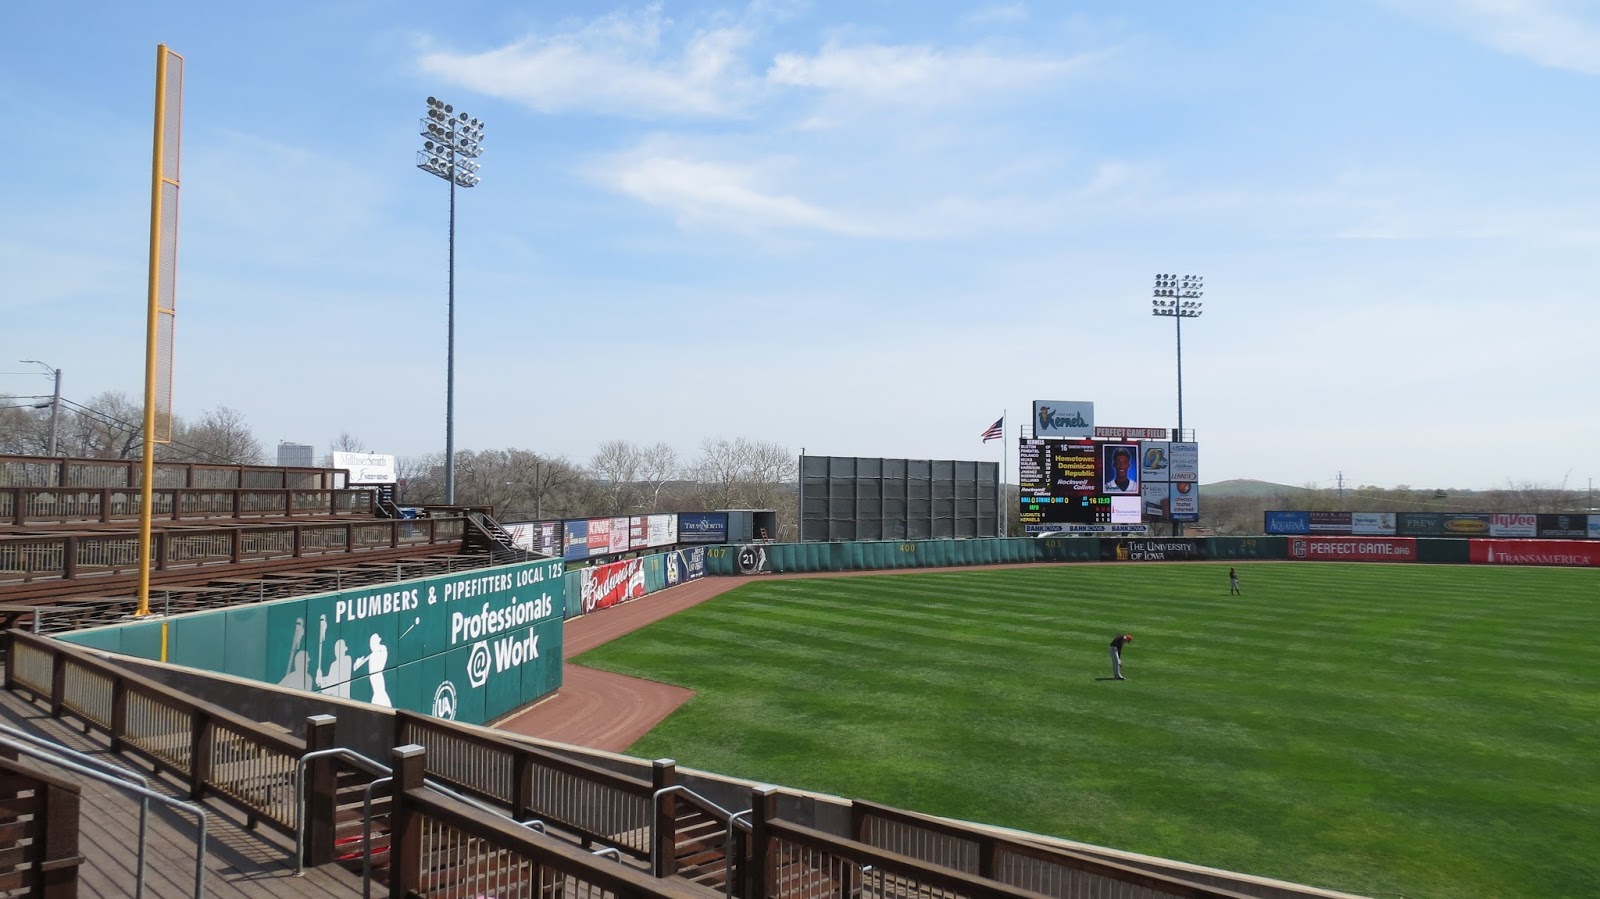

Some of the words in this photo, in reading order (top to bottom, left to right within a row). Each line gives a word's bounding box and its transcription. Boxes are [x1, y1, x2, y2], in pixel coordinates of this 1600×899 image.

[1041, 408, 1089, 430] Kernels
[1097, 428, 1126, 436] PERFECT
[1126, 428, 1146, 437] GAME
[1147, 429, 1164, 438] FIELD
[1270, 518, 1305, 531] AQUAFINA
[900, 544, 915, 552] 400
[1128, 542, 1145, 551] THE
[1147, 542, 1191, 551] UNIVERSITY
[1310, 543, 1356, 554] PERFECT
[1358, 543, 1409, 555] GAME.ORG
[707, 548, 725, 558] 407
[743, 554, 753, 564] 21
[1144, 551, 1165, 560] IOWA
[1497, 553, 1590, 564] TRANSAMERICA
[584, 559, 637, 610] Budweiser
[336, 589, 418, 624] PLUMBERS
[428, 586, 437, 606] &
[444, 575, 512, 602] PIPEFITTERS
[516, 567, 544, 588] LOCAL
[548, 563, 563, 579] 125
[452, 593, 552, 645] Professionals
[470, 643, 488, 683] @
[494, 627, 539, 673] Work
[438, 696, 452, 718] UA
